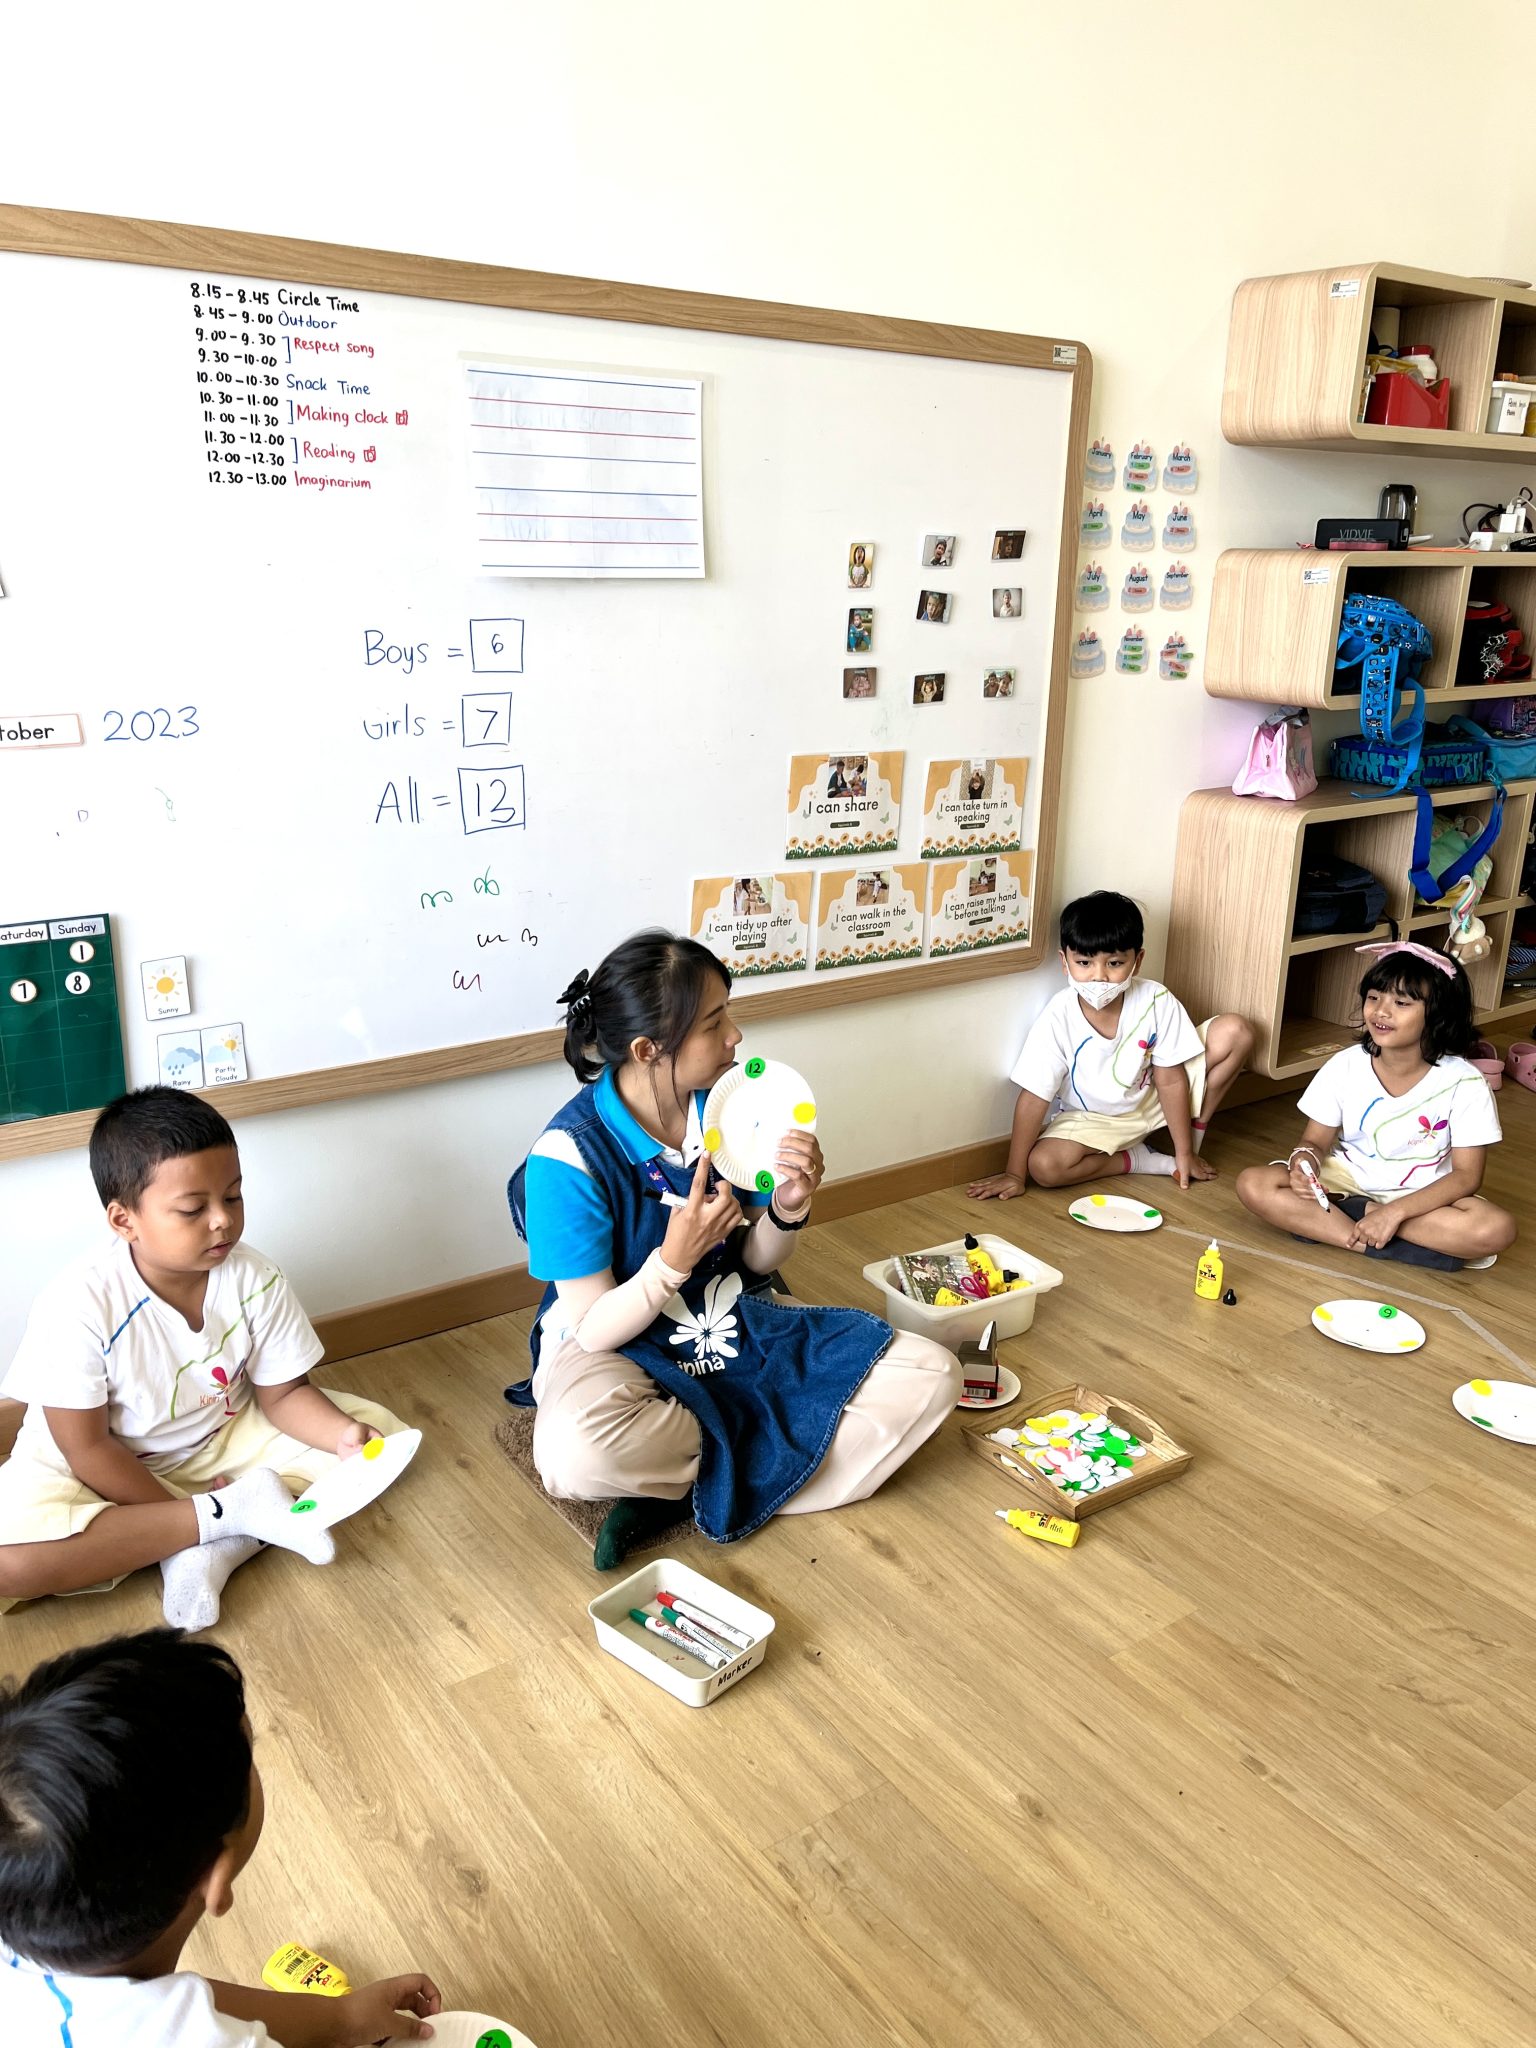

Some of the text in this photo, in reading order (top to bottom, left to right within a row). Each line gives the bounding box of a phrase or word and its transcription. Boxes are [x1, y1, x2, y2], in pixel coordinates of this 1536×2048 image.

[277, 289, 321, 307] Circle
[326, 296, 360, 313] Time
[278, 311, 338, 329] Outdoor
[294, 337, 340, 354] Respect
[346, 342, 374, 358] song
[286, 374, 327, 391] Snack
[337, 381, 371, 395] Time
[296, 404, 350, 427] Making
[354, 409, 389, 424] clock
[303, 441, 355, 463] Reading
[1092, 448, 1111, 458] January
[1131, 452, 1152, 461] February
[1173, 453, 1190, 461] March
[294, 470, 372, 491] Imaginarium
[1089, 510, 1103, 519] April
[1133, 511, 1145, 521] May
[1173, 513, 1187, 521] June
[1087, 572, 1100, 582] July
[1129, 575, 1148, 583] August
[364, 629, 429, 674] Boys
[491, 633, 504, 654] 6
[103, 706, 200, 741] 2023
[476, 708, 498, 740] 7
[0, 722, 54, 741] tober
[375, 776, 420, 824] All
[476, 779, 516, 823] 13
[815, 802, 840, 813] can
[844, 795, 879, 812] share
[945, 803, 961, 811] can
[963, 800, 981, 811] take
[982, 800, 998, 810] turn
[1000, 800, 1008, 809] in
[953, 811, 990, 825] speaking
[950, 902, 966, 913] can
[966, 899, 984, 909] raise
[986, 896, 997, 908] my
[998, 891, 1017, 903] hand
[840, 913, 857, 922] can
[859, 909, 880, 920] walk
[882, 908, 891, 918] in
[892, 906, 906, 917] the
[954, 904, 1006, 921] before talking
[58, 923, 97, 935] Sunday
[714, 923, 732, 932] can
[736, 920, 754, 934] tidy
[756, 920, 768, 931] up
[770, 917, 792, 928] after
[848, 919, 891, 933] classroom
[0, 928, 44, 941] aturday
[732, 929, 767, 944] playing
[80, 945, 84, 960] 1
[17, 983, 27, 998] 7
[74, 976, 82, 991] 8
[158, 1006, 179, 1015] Sunny
[215, 1066, 236, 1074] Partly
[749, 1063, 761, 1074] 12
[215, 1074, 238, 1082] Cloudy
[761, 1175, 769, 1188] 6
[717, 1656, 753, 1687] Marker
